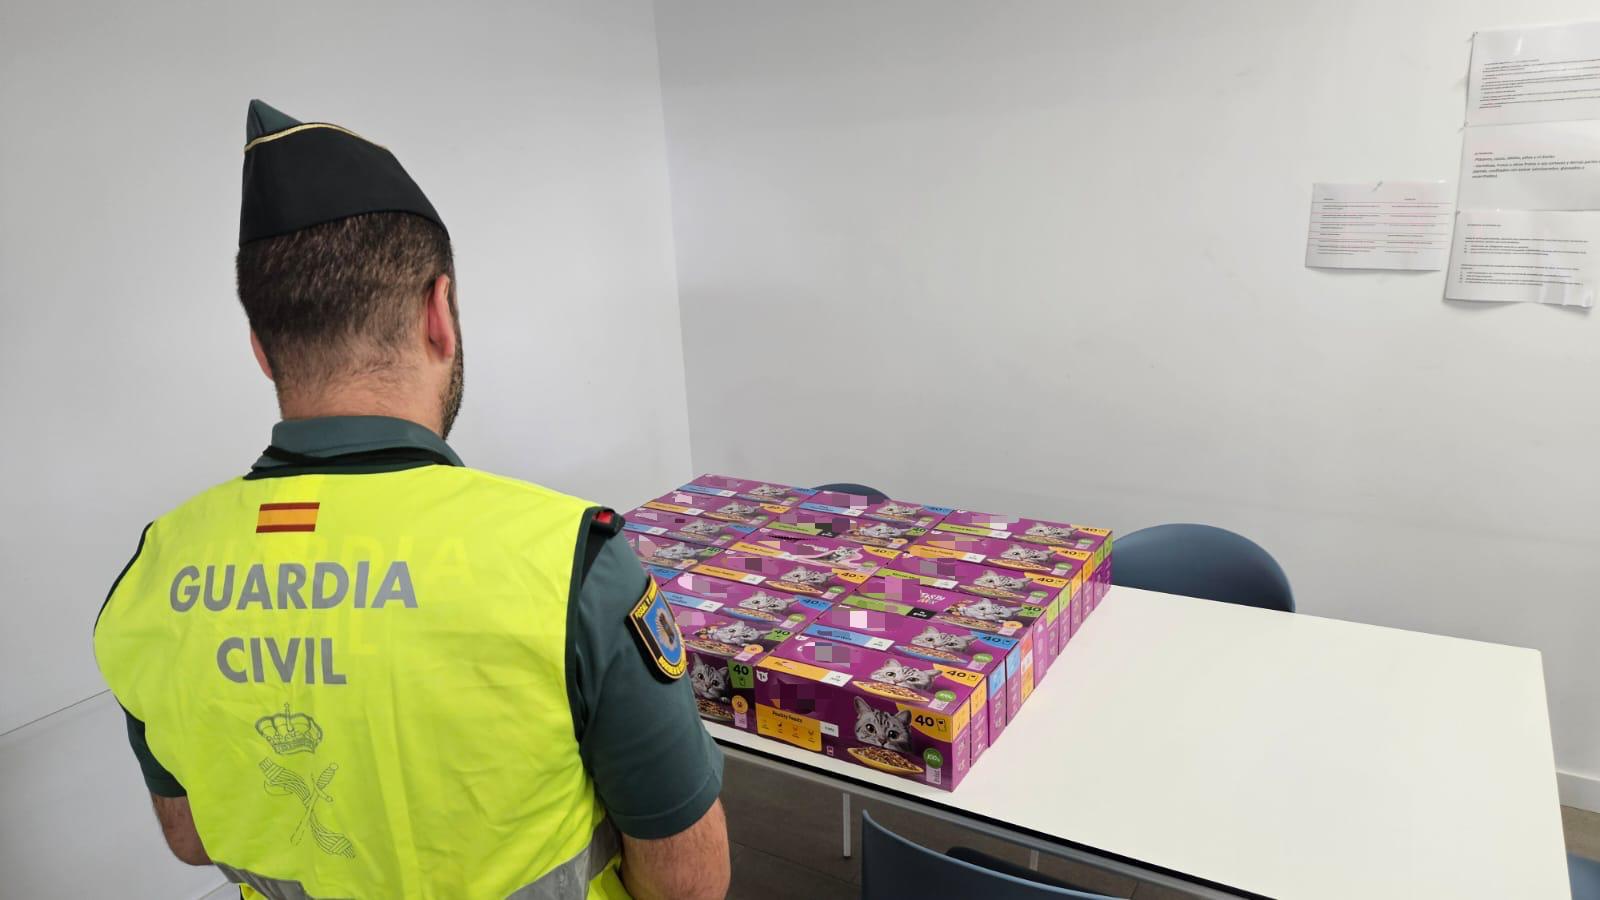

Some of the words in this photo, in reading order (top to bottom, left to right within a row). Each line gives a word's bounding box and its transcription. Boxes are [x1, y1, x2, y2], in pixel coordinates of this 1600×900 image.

[169, 560, 419, 613] GUARDIA
[215, 636, 347, 685] CIVIL
[733, 664, 749, 676] 40
[946, 670, 967, 678] 40
[914, 714, 935, 727] 40
